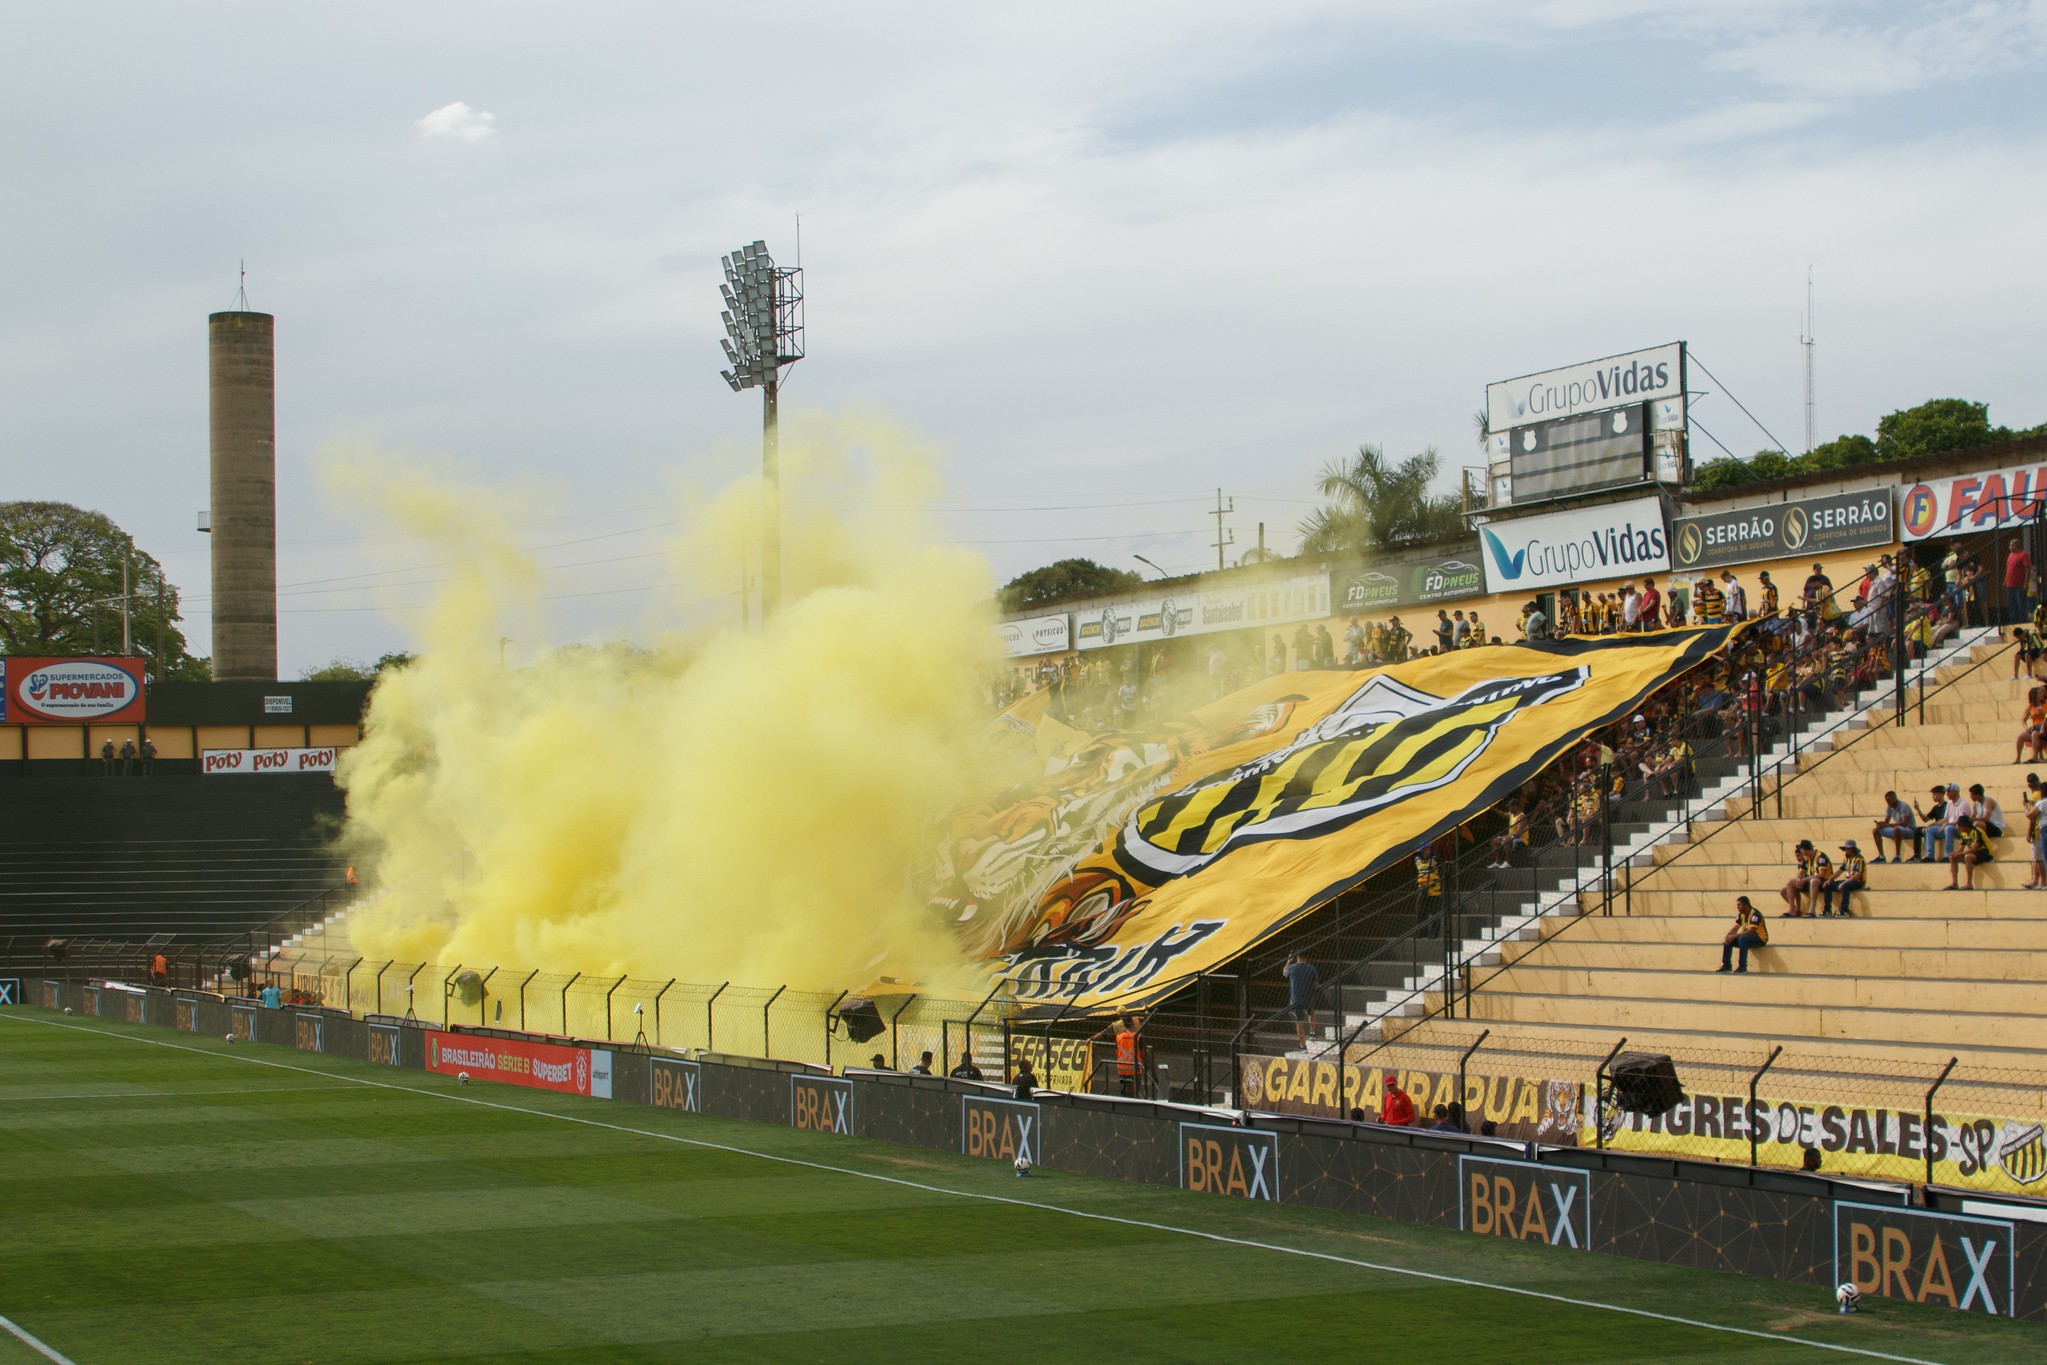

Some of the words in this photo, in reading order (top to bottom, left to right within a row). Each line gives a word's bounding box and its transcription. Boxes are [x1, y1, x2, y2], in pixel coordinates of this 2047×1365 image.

[1706, 516, 1774, 545] SERRÃO
[1813, 499, 1887, 530] SERRÃO
[1706, 546, 1738, 556] CORRETORA
[1749, 540, 1775, 549] SEGUROS
[1813, 531, 1848, 541] CORRETORA
[1859, 524, 1887, 533] SEGUROS
[1342, 601, 1364, 609] CENTRO
[1364, 598, 1398, 607] AUTOMOTIVO
[1419, 592, 1442, 600] CENTRO
[1443, 586, 1479, 596] AUTOMOTIVO
[1035, 626, 1064, 638] PHYSICUS
[49, 682, 125, 700] PIOVANI
[50, 673, 124, 681] SUPERMERCADOS
[298, 1021, 322, 1052] BRAX
[370, 1032, 398, 1066] BRAX
[1011, 1035, 1088, 1071] SERSEG
[441, 1047, 496, 1070] BRASILEIRÃO
[497, 1050, 523, 1073] SÉRIE
[523, 1057, 530, 1074] B
[532, 1058, 573, 1083] SUPERBET
[654, 1067, 696, 1112] BRAX
[1265, 1056, 1383, 1114] GARRA
[796, 1086, 848, 1135] BRAX
[1778, 1102, 1816, 1149] DE
[969, 1109, 1033, 1164] BRAX
[1188, 1138, 1270, 1200] BRAX
[1471, 1172, 1579, 1249] BRAX
[1851, 1222, 1998, 1315] BRAX
